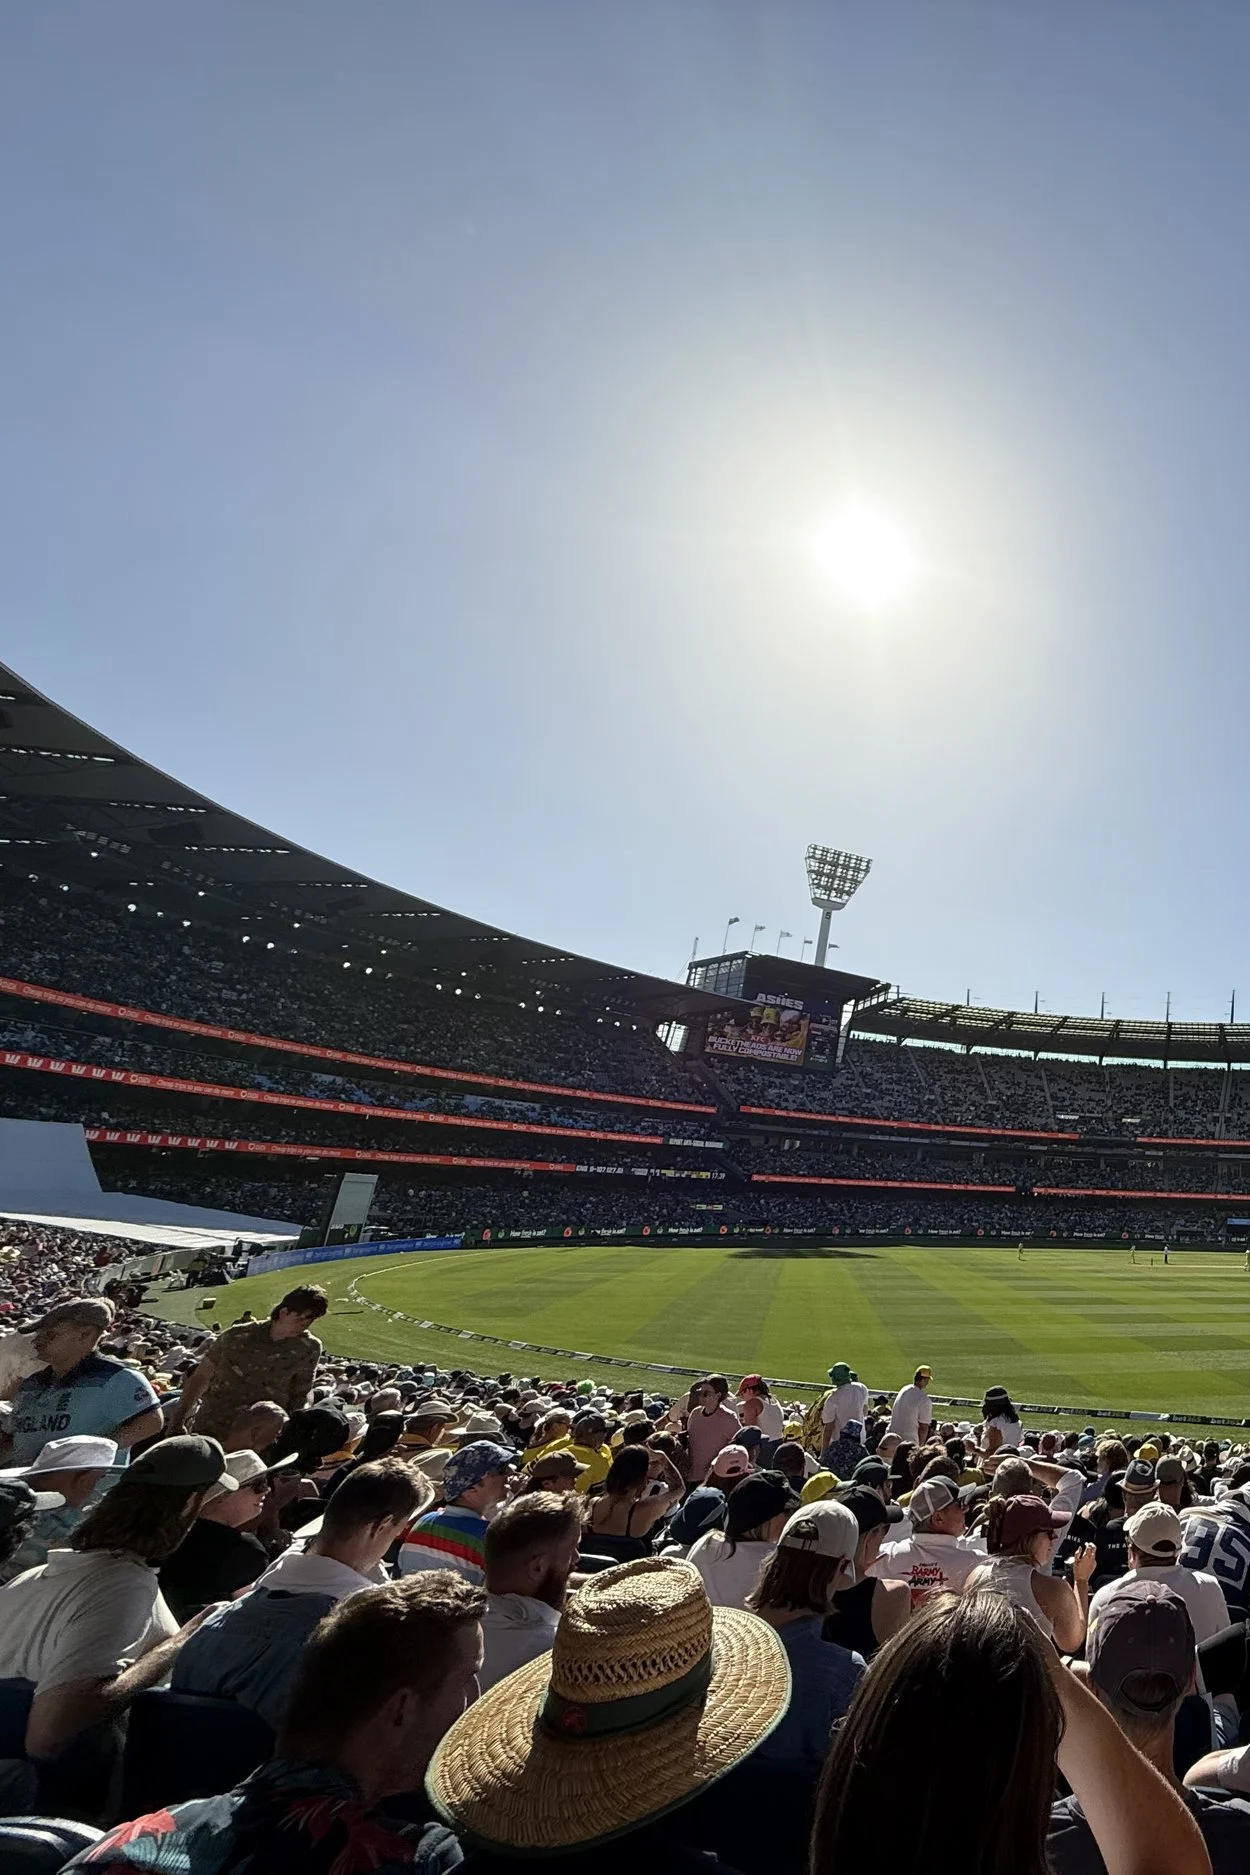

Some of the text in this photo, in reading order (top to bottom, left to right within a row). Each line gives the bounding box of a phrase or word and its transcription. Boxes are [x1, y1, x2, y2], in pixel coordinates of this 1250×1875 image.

[825, 912, 832, 920] 5
[756, 992, 804, 1010] ASHES
[708, 1036, 802, 1056] BUCKETHEADS ARE NOW
[713, 1043, 740, 1052] FULLY
[912, 1565, 940, 1576] BARMY
[908, 1575, 937, 1587] ARMY
